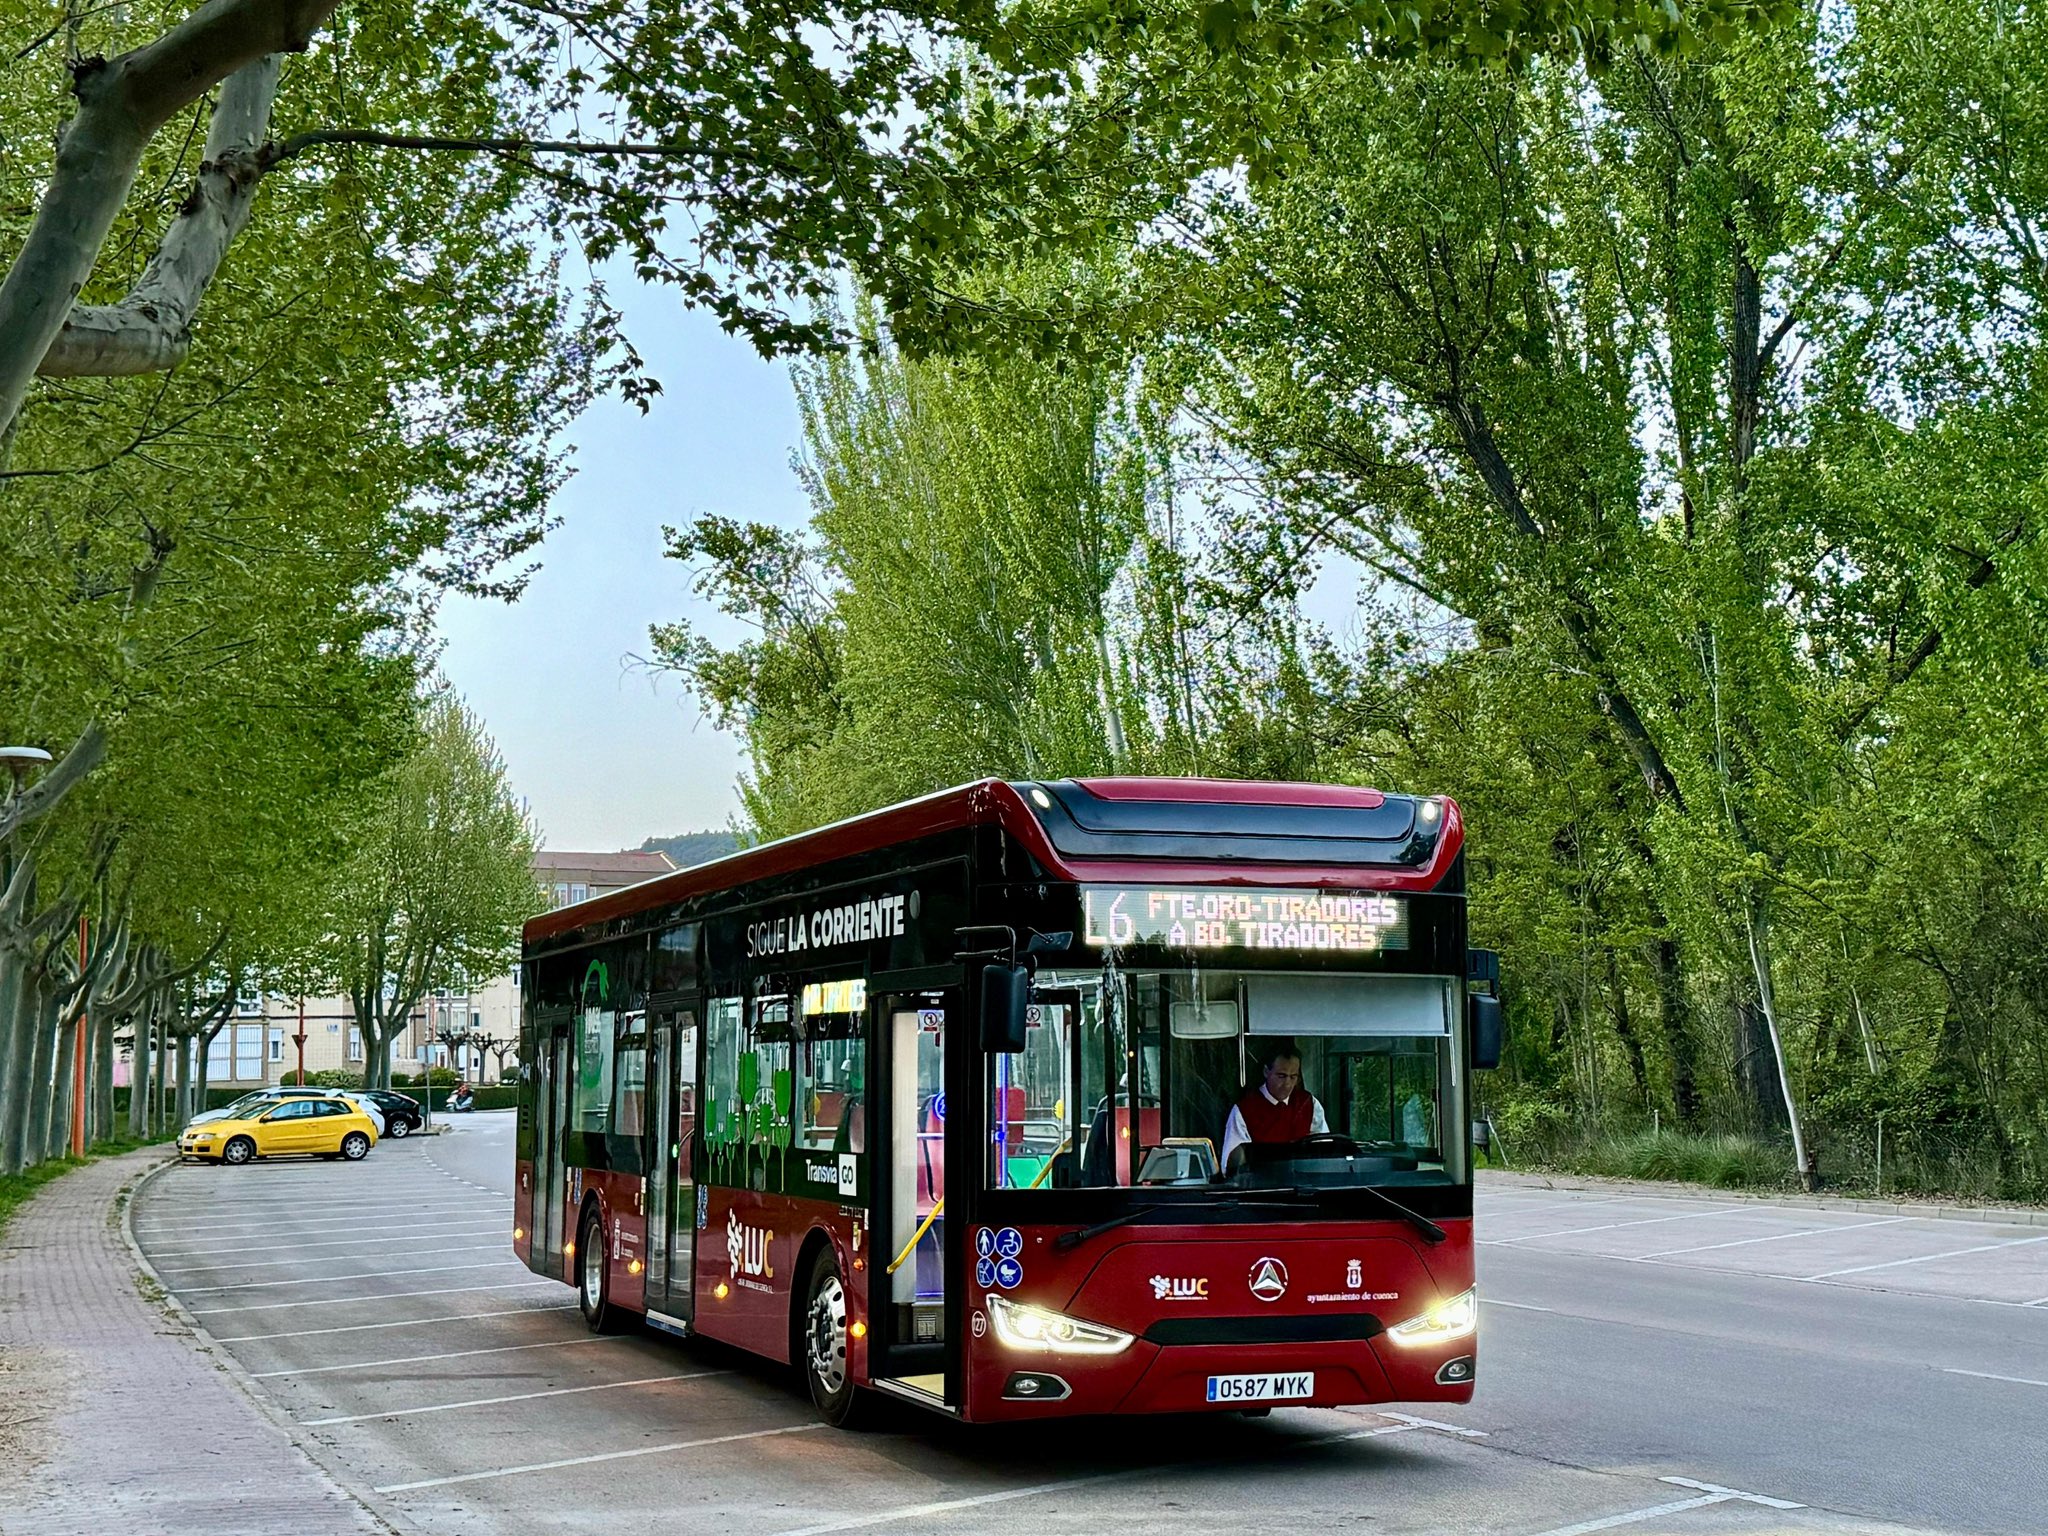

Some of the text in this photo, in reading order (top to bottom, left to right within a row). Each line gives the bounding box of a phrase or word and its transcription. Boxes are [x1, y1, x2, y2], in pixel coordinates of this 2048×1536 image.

[747, 895, 904, 958] SIGUE LA CORRIENTE
[1085, 890, 1133, 944] L6
[1169, 920, 1186, 946] A
[1239, 921, 1377, 949] TIRADORES
[841, 1165, 854, 1185] GO
[744, 1225, 774, 1279] LUC
[1173, 1277, 1209, 1296] LUC
[1307, 1291, 1399, 1304] ayuntamiento de cuenca
[1220, 1376, 1308, 1398] 0587 MYK
